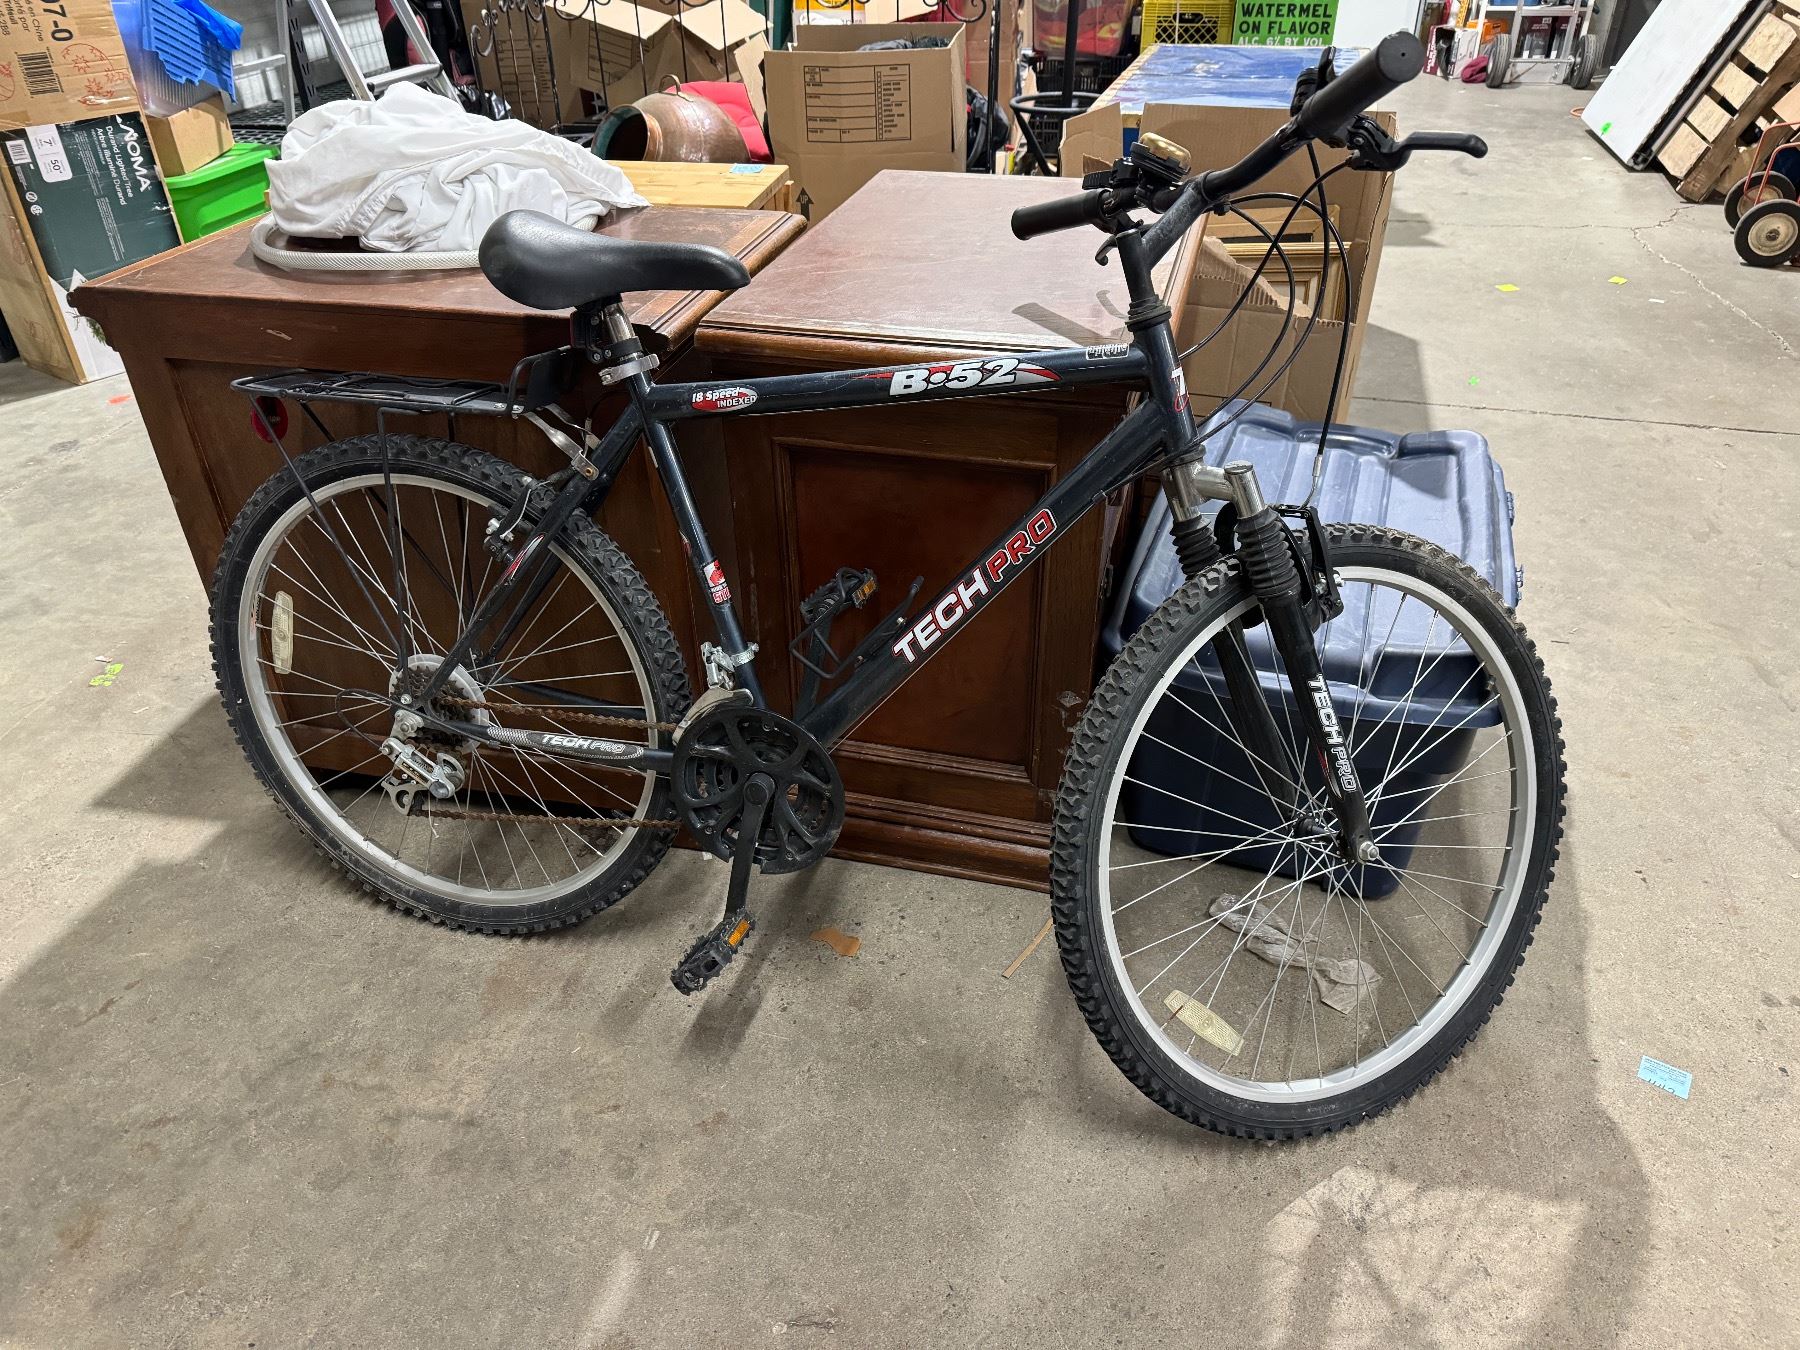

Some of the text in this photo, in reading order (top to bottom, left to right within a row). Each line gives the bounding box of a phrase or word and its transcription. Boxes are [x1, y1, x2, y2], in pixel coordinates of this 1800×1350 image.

[42, 0, 73, 41] 7-0
[1241, 2, 1332, 18] WATERMEL
[18, 16, 31, 32] par
[32, 18, 44, 41] Chine
[1239, 20, 1331, 35] ON FLAVOR
[1284, 36, 1299, 46] BY
[106, 125, 134, 198] Durand Lighted Tree
[115, 115, 151, 193] NOMA
[96, 127, 108, 148] Arbre
[113, 178, 128, 206] Durand
[800, 194, 809, 205] UP
[692, 386, 740, 403] 18 Speed
[716, 394, 757, 408] INDEXED
[892, 508, 1058, 664] TECH PRO
[541, 733, 626, 755] TECH PRO
[1307, 674, 1358, 793] TECH PRO
